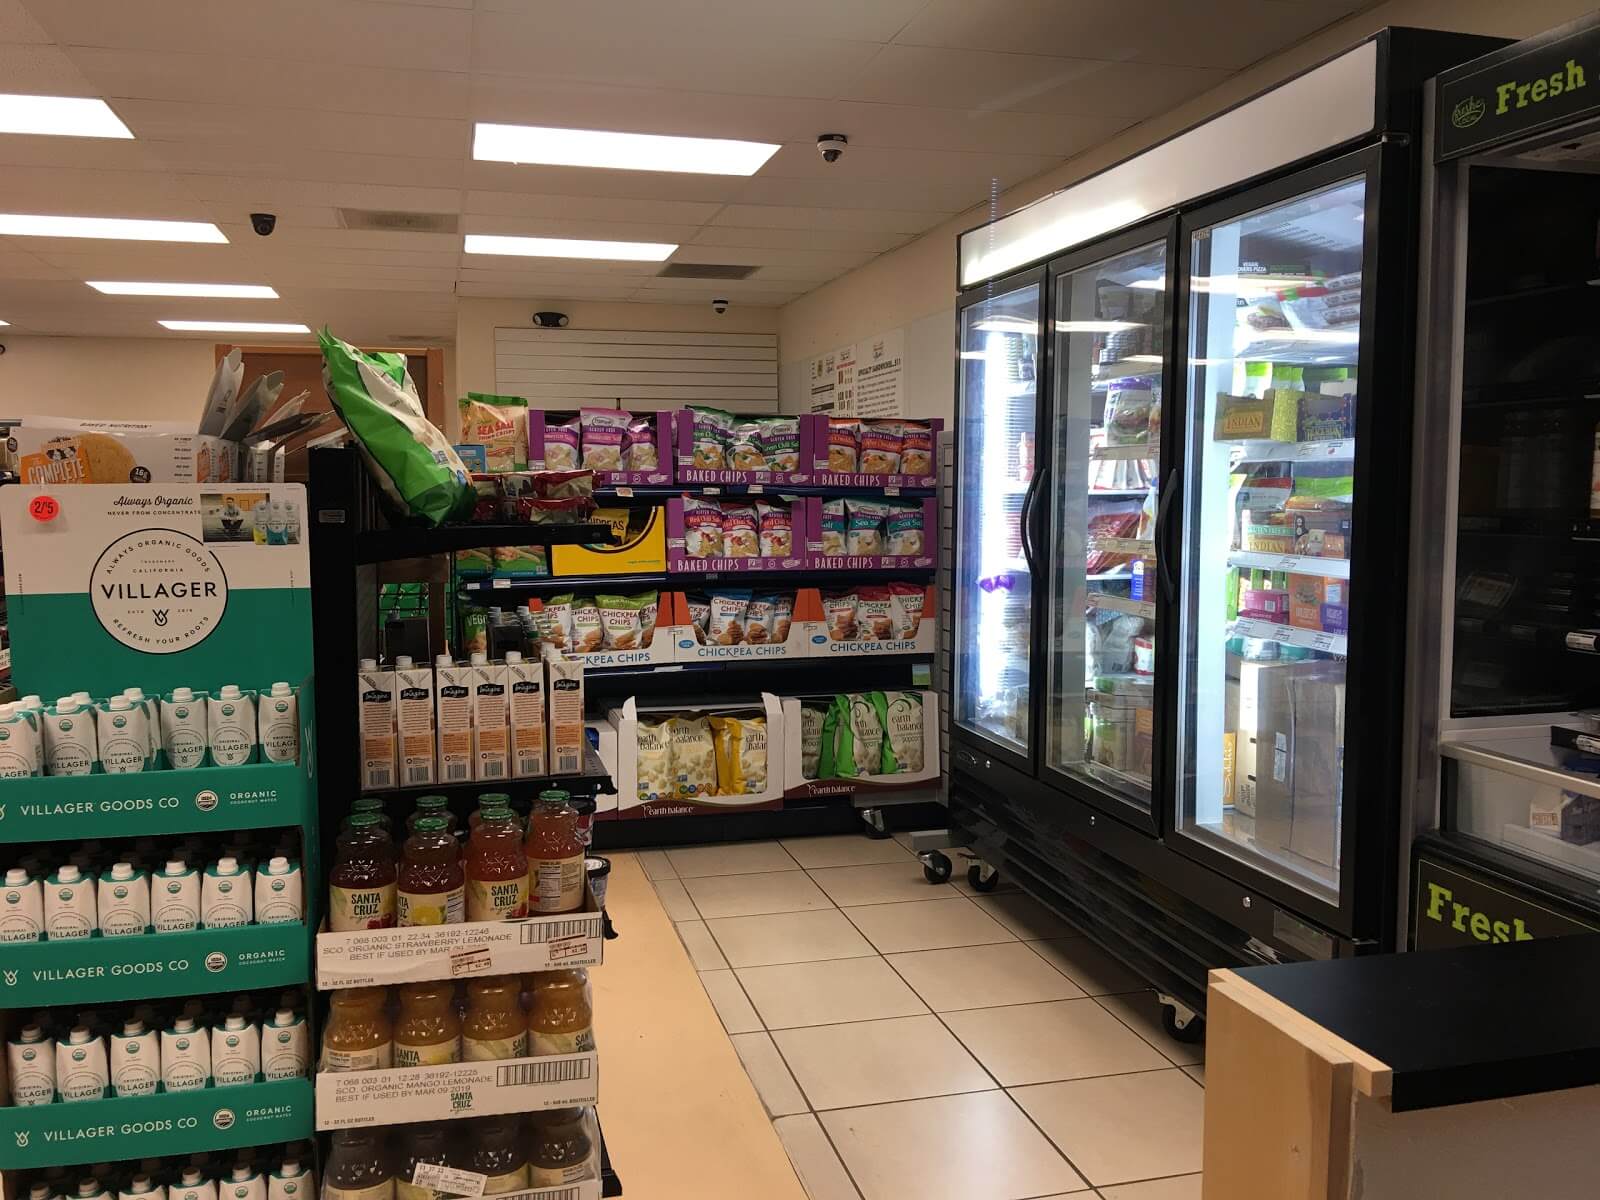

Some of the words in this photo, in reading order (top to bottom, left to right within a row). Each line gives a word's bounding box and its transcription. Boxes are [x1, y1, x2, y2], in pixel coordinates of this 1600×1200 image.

[1495, 59, 1586, 115] Fresh
[28, 459, 86, 484] COMPLETE
[686, 470, 716, 482] BAKED
[720, 470, 747, 483] CHIPS
[822, 474, 851, 486] BAKED
[854, 475, 880, 486] CHIPS
[113, 495, 152, 508] Always
[154, 495, 193, 508] Organic
[856, 519, 870, 527] Sea
[106, 546, 134, 574] ALWAYS
[138, 539, 181, 549] ORGANIC
[185, 548, 211, 573] GOODS
[678, 559, 708, 571] BAKED
[712, 559, 739, 571] CHIPS
[815, 558, 844, 569] BAKED
[847, 557, 873, 568] CHIPS
[101, 581, 217, 599] VILLAGER
[577, 615, 599, 623] CHIPS
[602, 610, 638, 618] CHICKPEA
[609, 618, 631, 626] CHIPS
[113, 617, 150, 643] REFRESH
[156, 636, 180, 645] YOUR
[184, 616, 209, 638] ROOTS
[698, 647, 752, 658] CHICKPEA
[755, 646, 786, 656] CHIPS
[830, 642, 883, 653] CHICKPEA
[886, 642, 916, 651] CHIPS
[580, 654, 614, 666] CKPEA
[617, 652, 650, 662] CHIPS
[266, 739, 296, 748] VILLAGE
[229, 790, 277, 800] ORGANIC
[831, 785, 856, 793] balance
[20, 802, 94, 816] VILLAGER
[100, 799, 154, 812] GOODS
[159, 797, 180, 809] CO
[648, 806, 667, 816] earth
[668, 805, 696, 815] balance
[491, 883, 519, 896] SANTA
[351, 893, 382, 904] SANTA
[494, 895, 518, 907] CRUZ
[353, 904, 380, 916] CRUZ
[104, 926, 142, 935] VILLAGER
[157, 922, 194, 931] VILLAGER
[0, 932, 37, 941] ILLAGER
[348, 943, 392, 953] ORGANIC
[395, 936, 460, 949] STRAWBERRY
[462, 934, 512, 944] LEMONADE
[238, 949, 286, 960] ORGANIC
[388, 950, 414, 958] USED
[33, 966, 105, 981] VILLAGER
[111, 961, 163, 976] GOODS
[168, 959, 189, 971] CO
[513, 1038, 527, 1051] SAN
[575, 1034, 590, 1046] SAN
[361, 1082, 404, 1093] ORGANIC
[406, 1080, 440, 1089] MANGO
[442, 1075, 493, 1086] LEMONADE
[336, 1094, 360, 1103] BEST
[373, 1091, 399, 1100] USED
[416, 1088, 436, 1096] MAR
[450, 1091, 473, 1101] SANTA
[452, 1100, 471, 1109] CRUZ
[246, 1105, 292, 1117] ORGANIC
[44, 1126, 115, 1142] VILLAGER
[121, 1120, 172, 1135] GOODS
[177, 1117, 198, 1129] CO
